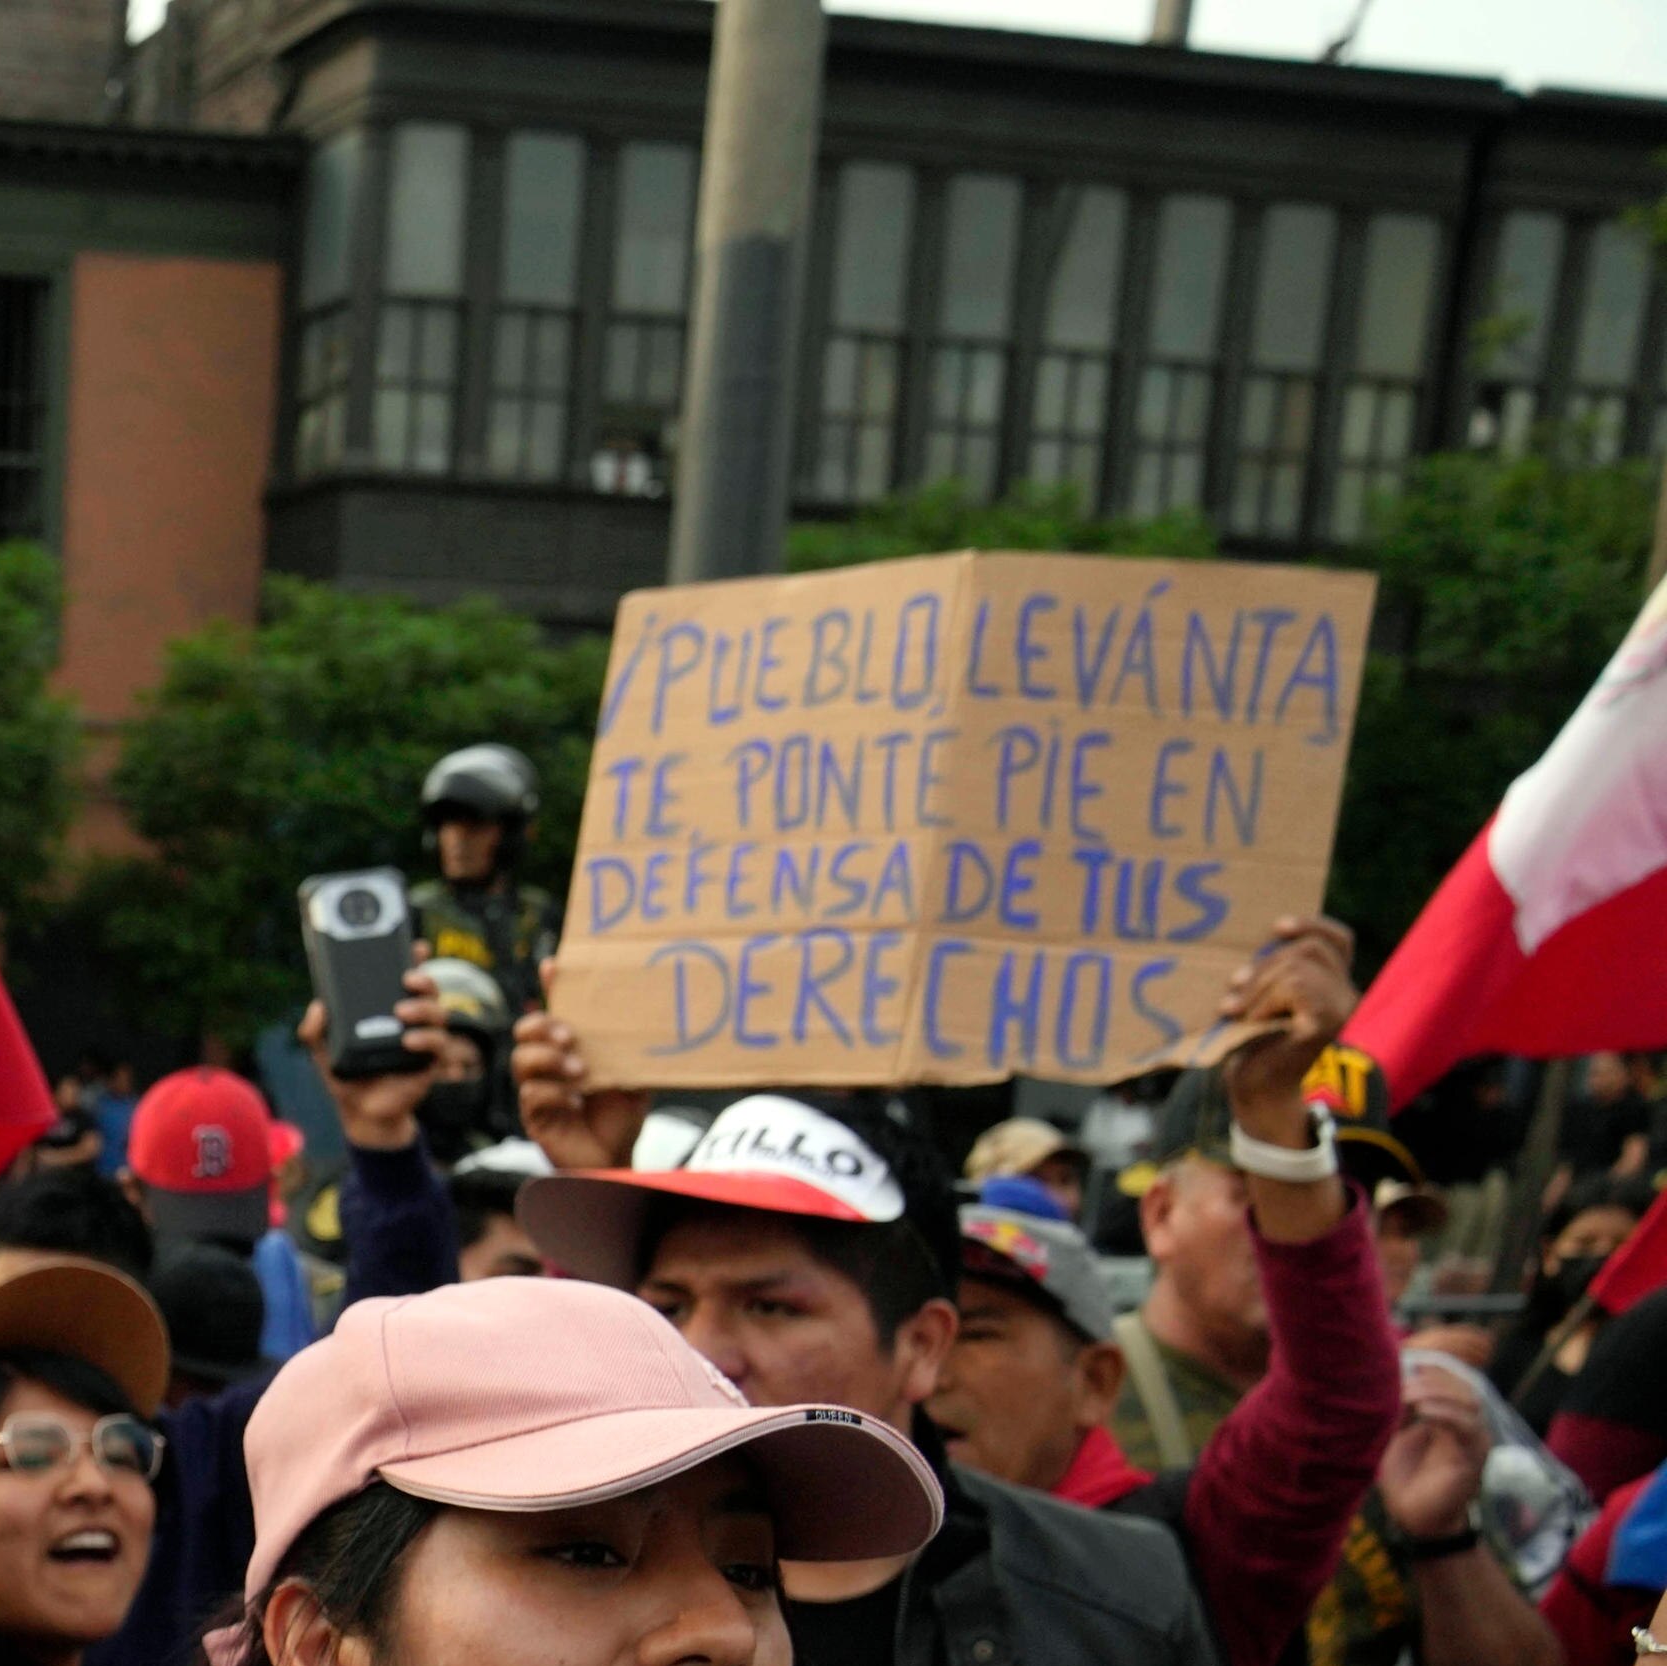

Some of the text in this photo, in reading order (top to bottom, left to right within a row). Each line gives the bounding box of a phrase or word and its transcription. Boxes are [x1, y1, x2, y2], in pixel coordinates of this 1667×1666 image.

[732, 728, 962, 830] PONTE
[992, 722, 1113, 838] PIE
[1150, 738, 1264, 847] EN
[586, 838, 1233, 942] DEFENSA DE TUS
[191, 1124, 233, 1178] B
[815, 1410, 853, 1423] QUEEN
